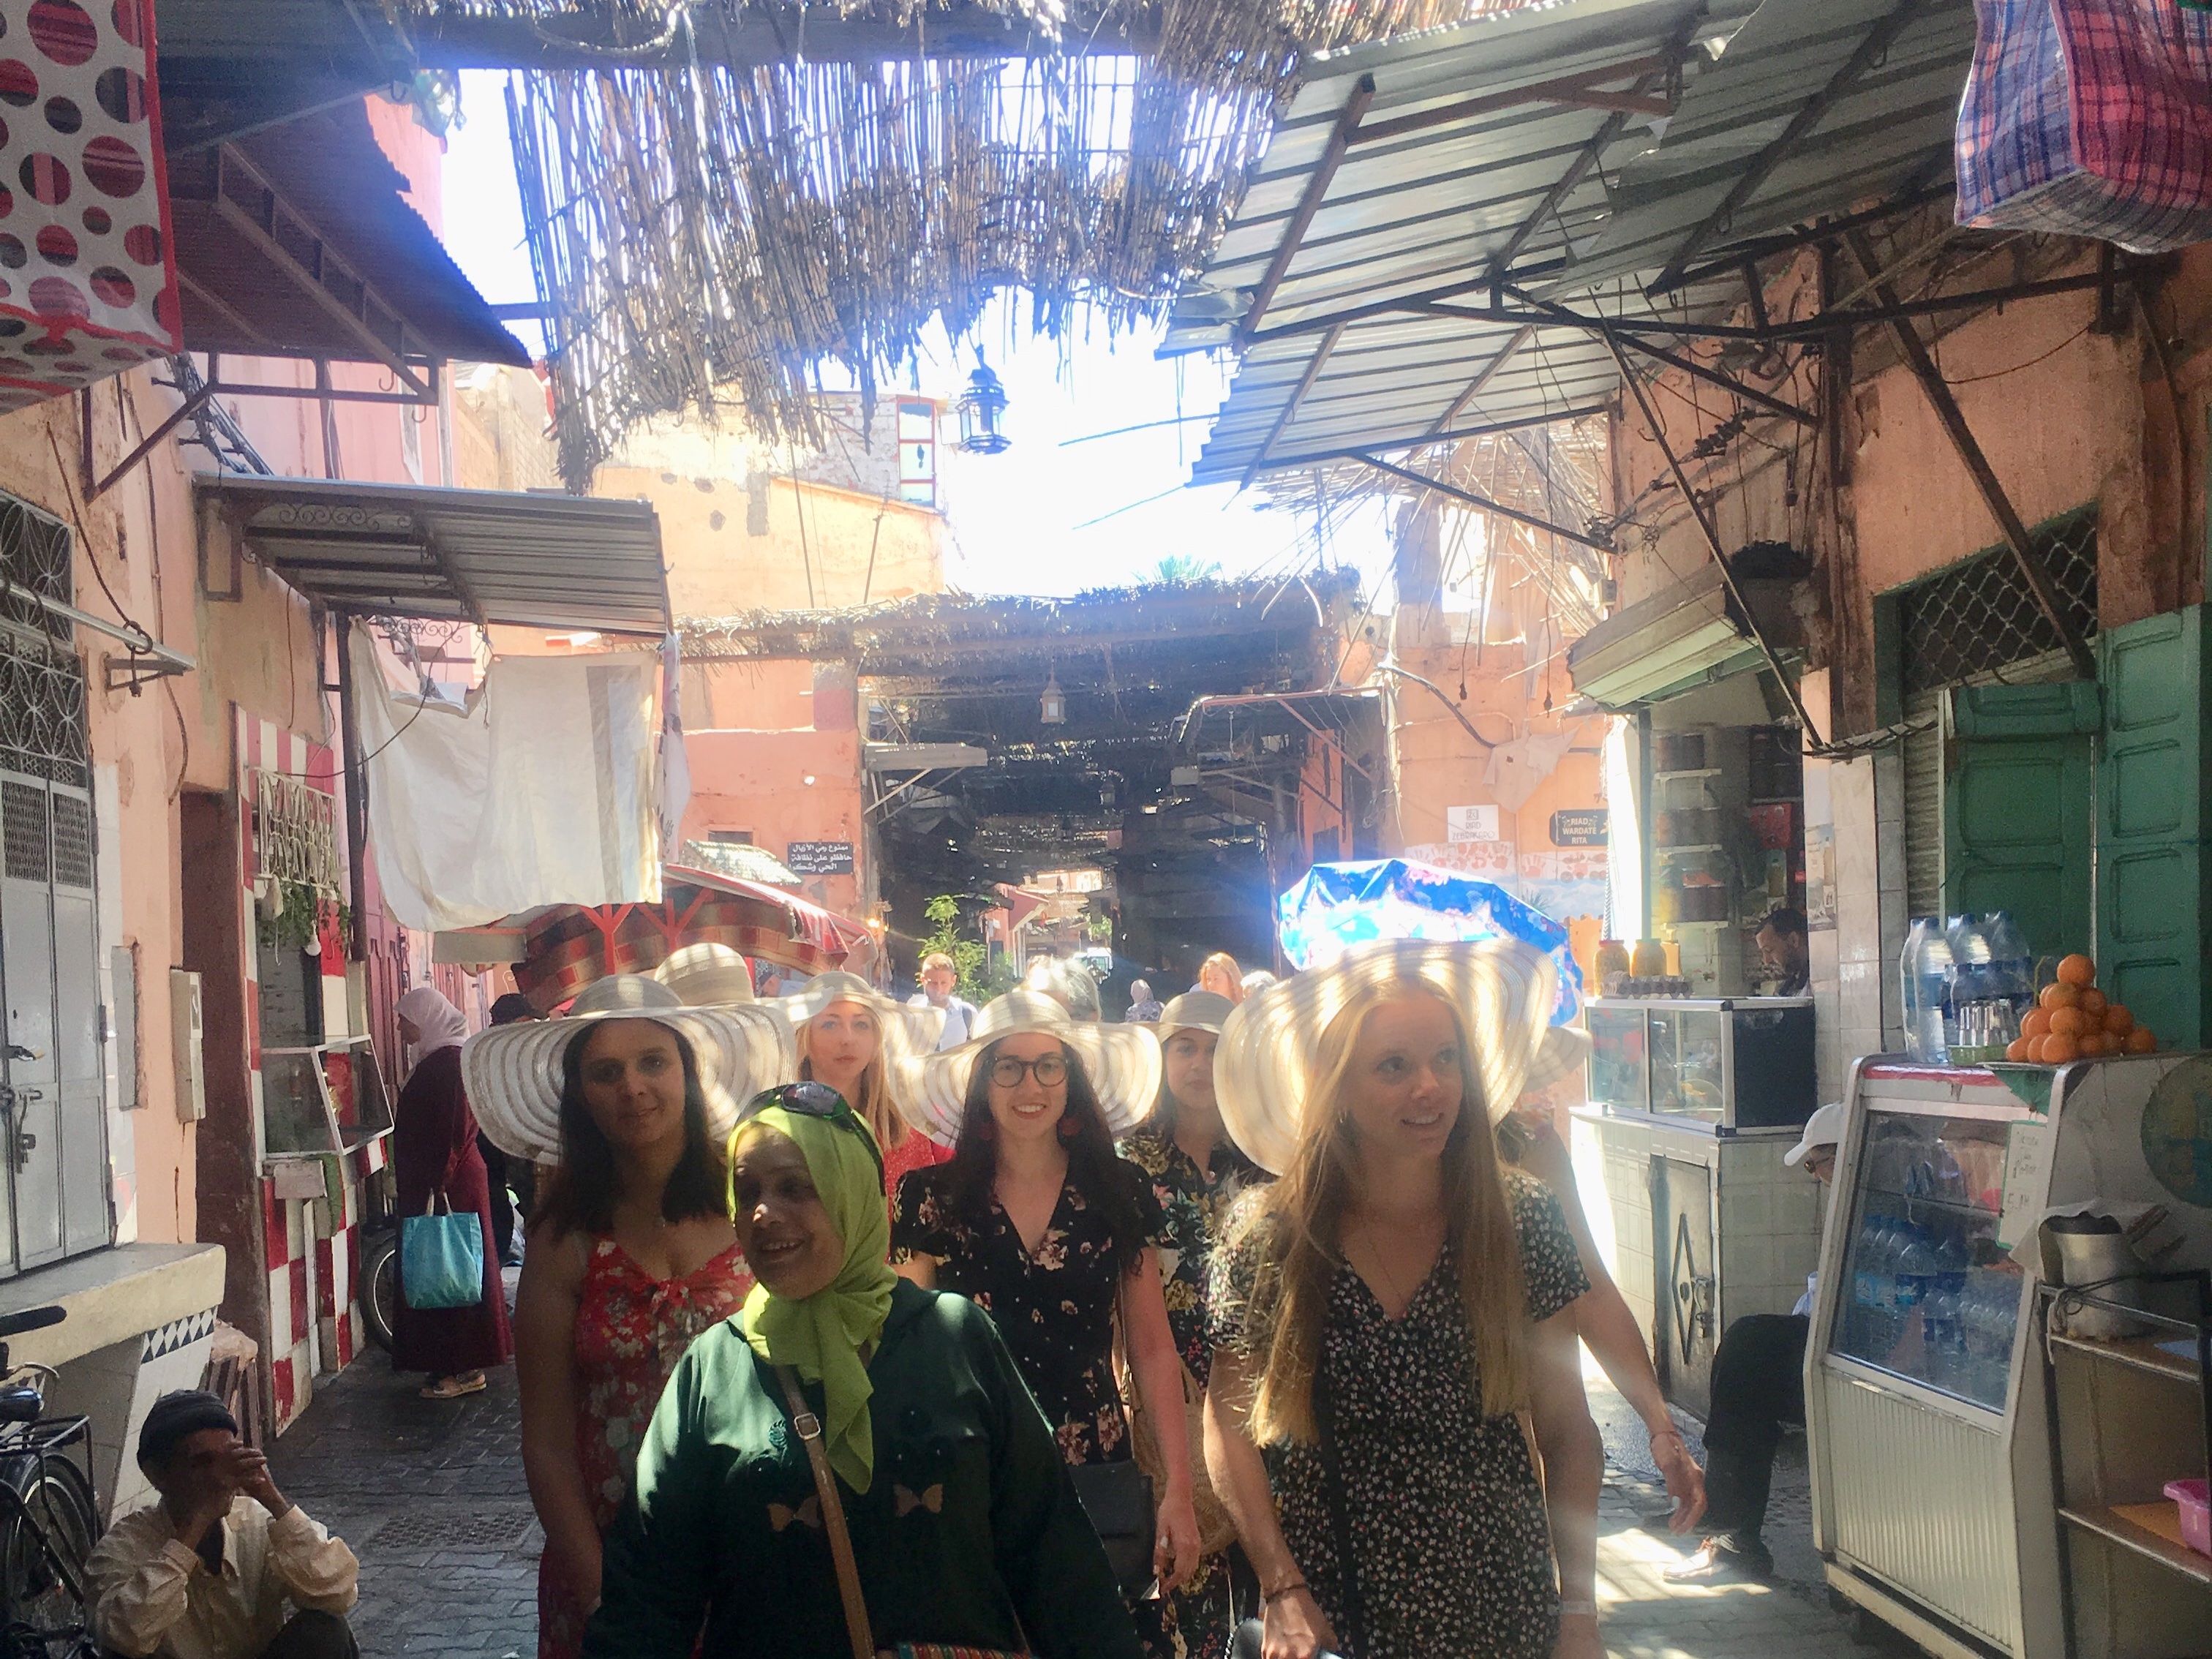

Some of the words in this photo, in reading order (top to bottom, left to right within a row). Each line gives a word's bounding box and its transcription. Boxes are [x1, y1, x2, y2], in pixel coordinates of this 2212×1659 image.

[1571, 817, 1588, 825] RIAD
[1465, 821, 1481, 830] RIAD
[1562, 827, 1597, 835] WARDATE
[828, 843, 849, 852] ممنوع
[813, 854, 827, 862] على
[818, 862, 837, 873] الحي
